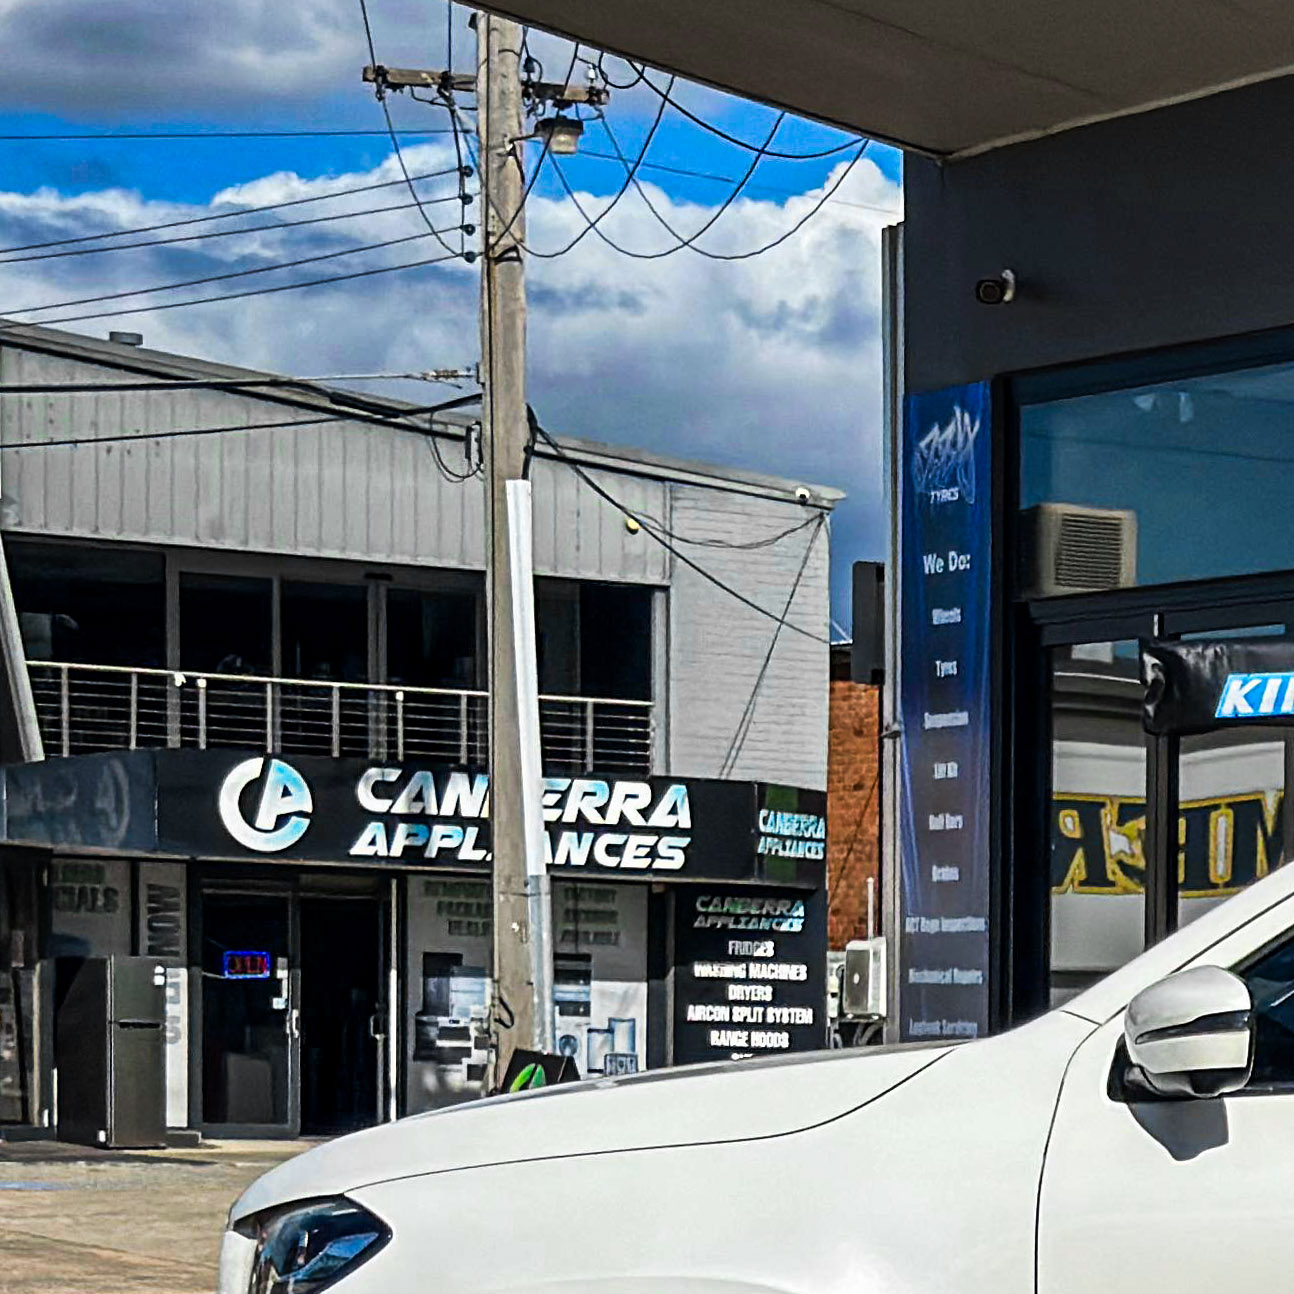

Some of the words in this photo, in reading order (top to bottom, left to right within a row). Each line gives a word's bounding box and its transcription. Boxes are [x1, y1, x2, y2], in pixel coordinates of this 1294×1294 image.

[923, 553, 944, 575] We
[356, 766, 691, 828] CANERRA
[759, 809, 825, 839] CANBERRA
[349, 821, 690, 869] APPLNCES
[748, 962, 807, 981] MACHINES
[728, 984, 773, 1001] DRYERS
[687, 1005, 730, 1021] AIRCON
[732, 1006, 765, 1023] SPLIT
[766, 1007, 813, 1024] SYSTEM
